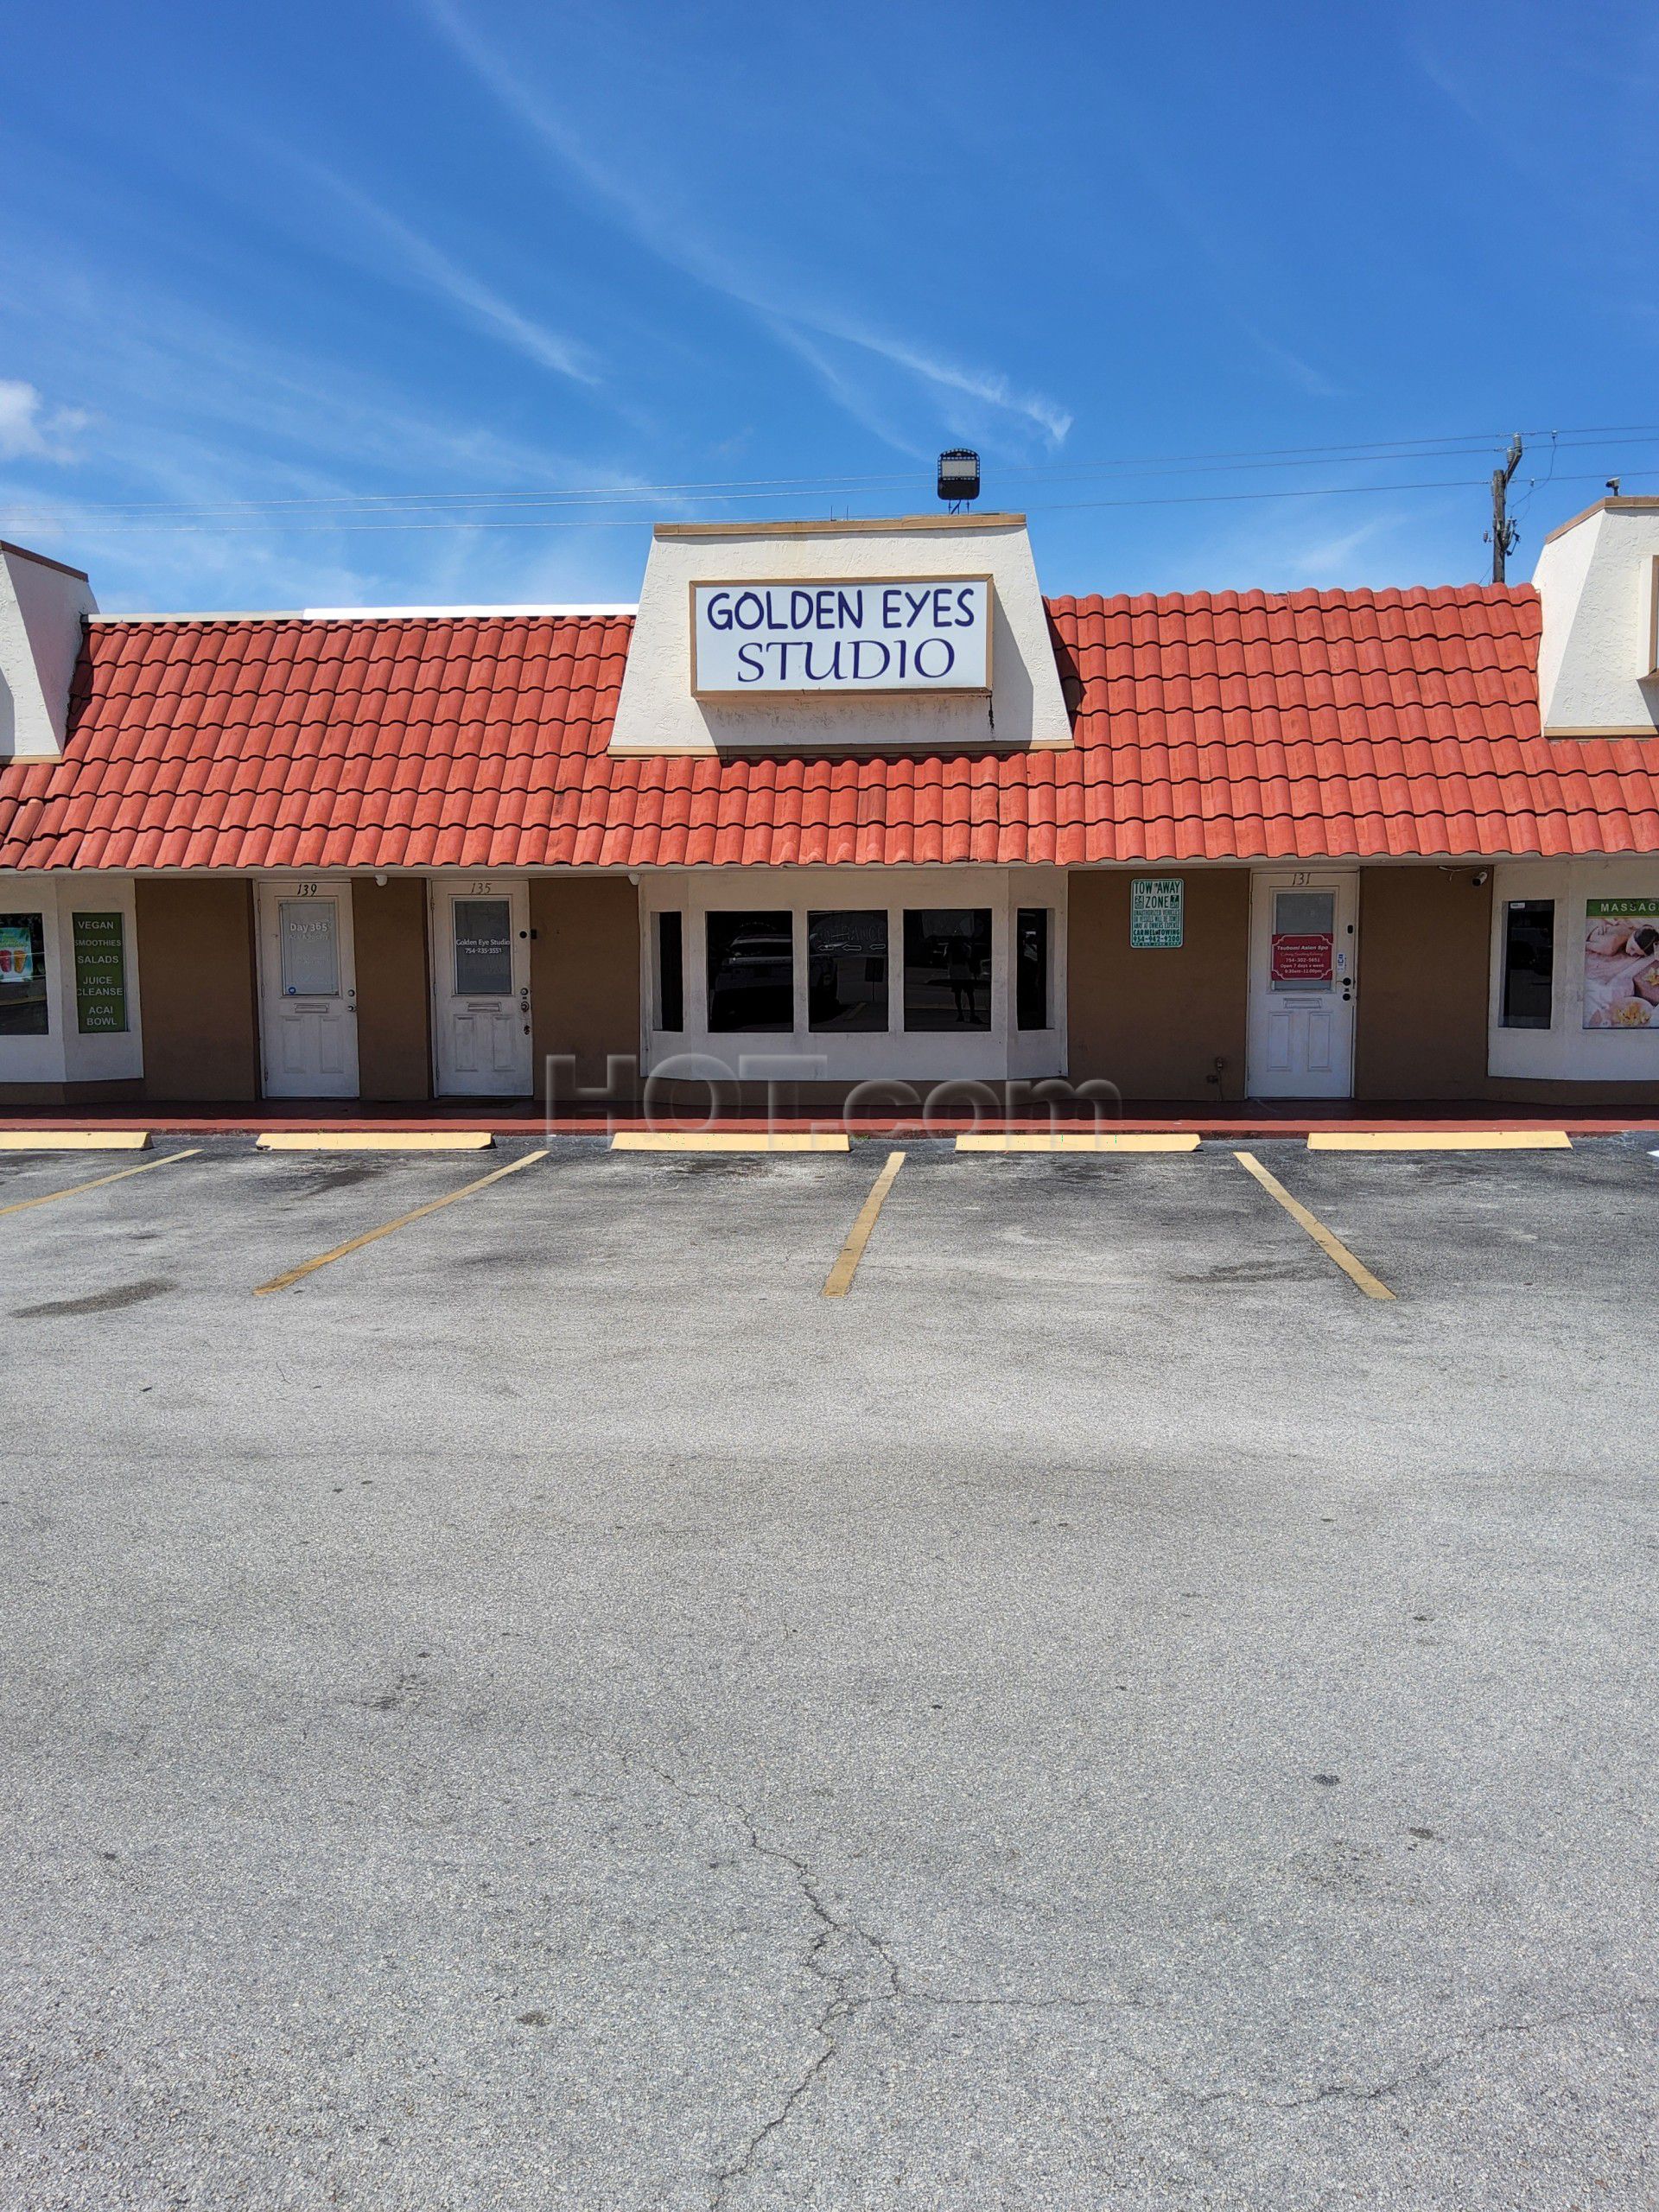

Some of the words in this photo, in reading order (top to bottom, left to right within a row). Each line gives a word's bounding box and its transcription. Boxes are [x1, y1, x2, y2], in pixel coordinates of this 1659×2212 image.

[707, 589, 863, 630] GOLDEN
[882, 588, 975, 629] EYES
[737, 638, 956, 683] STUDIO
[1292, 872, 1311, 885] 131
[297, 884, 317, 896] 139
[471, 882, 492, 894] 135
[1134, 881, 1153, 894] TOW
[1157, 881, 1180, 894] AWAY
[1145, 895, 1169, 908] ZONE
[1600, 903, 1659, 912] MASSAG
[78, 921, 114, 930] VEGAN
[289, 923, 308, 933] Day
[310, 921, 328, 931] 365
[478, 938, 490, 947] Eye
[77, 956, 119, 964] SALADS
[83, 976, 113, 985] JUICE
[77, 988, 124, 996] CLEANSE
[88, 1006, 113, 1014] ACAI
